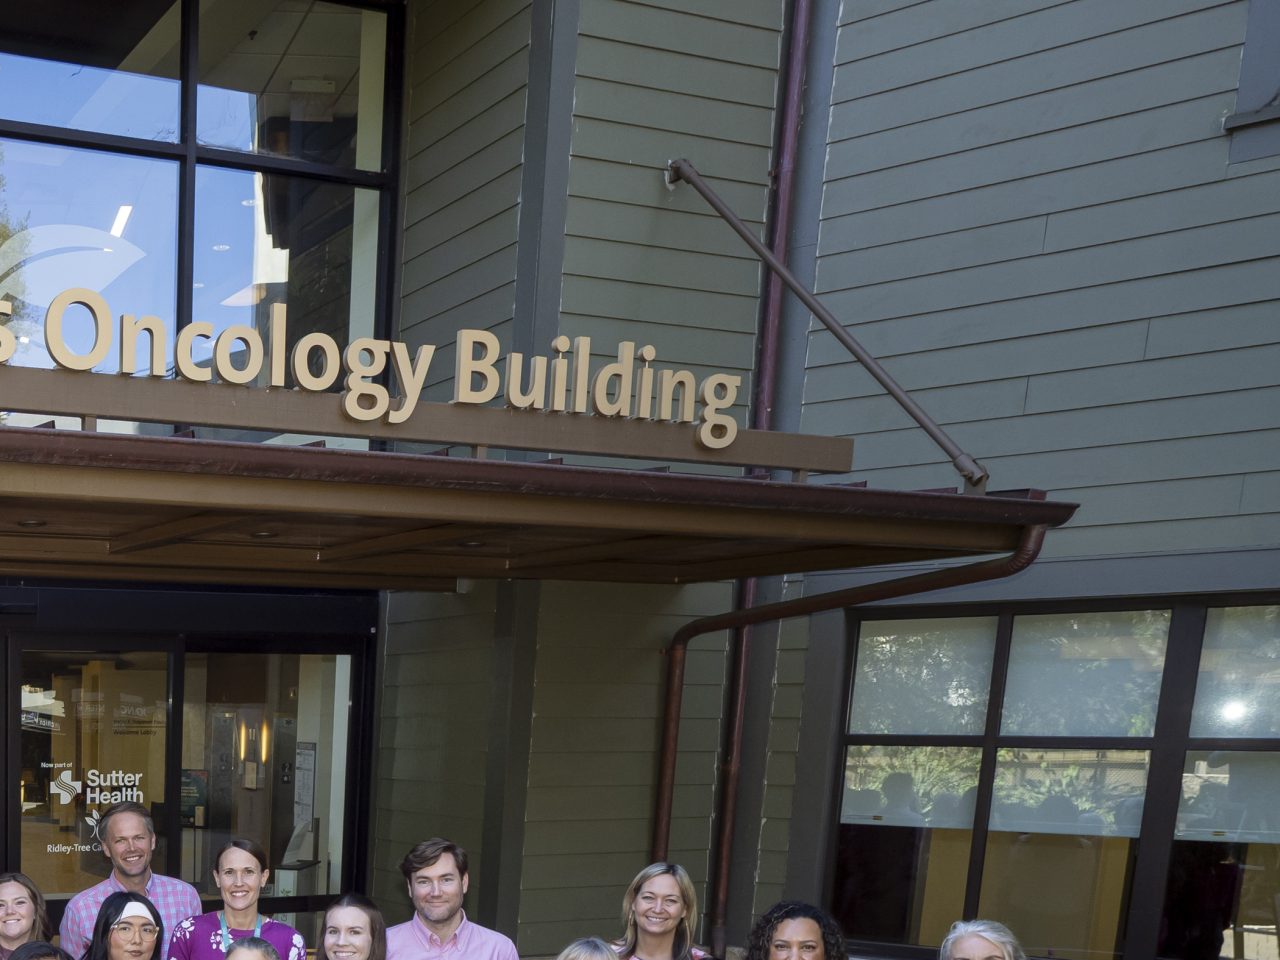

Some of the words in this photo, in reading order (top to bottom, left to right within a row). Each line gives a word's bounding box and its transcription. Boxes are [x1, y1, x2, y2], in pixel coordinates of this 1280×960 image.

[44, 287, 437, 424] Oncology
[454, 328, 742, 449] Building
[86, 769, 143, 787] Sutter
[86, 787, 144, 804] Health
[47, 843, 91, 855] Ridley-Tree
